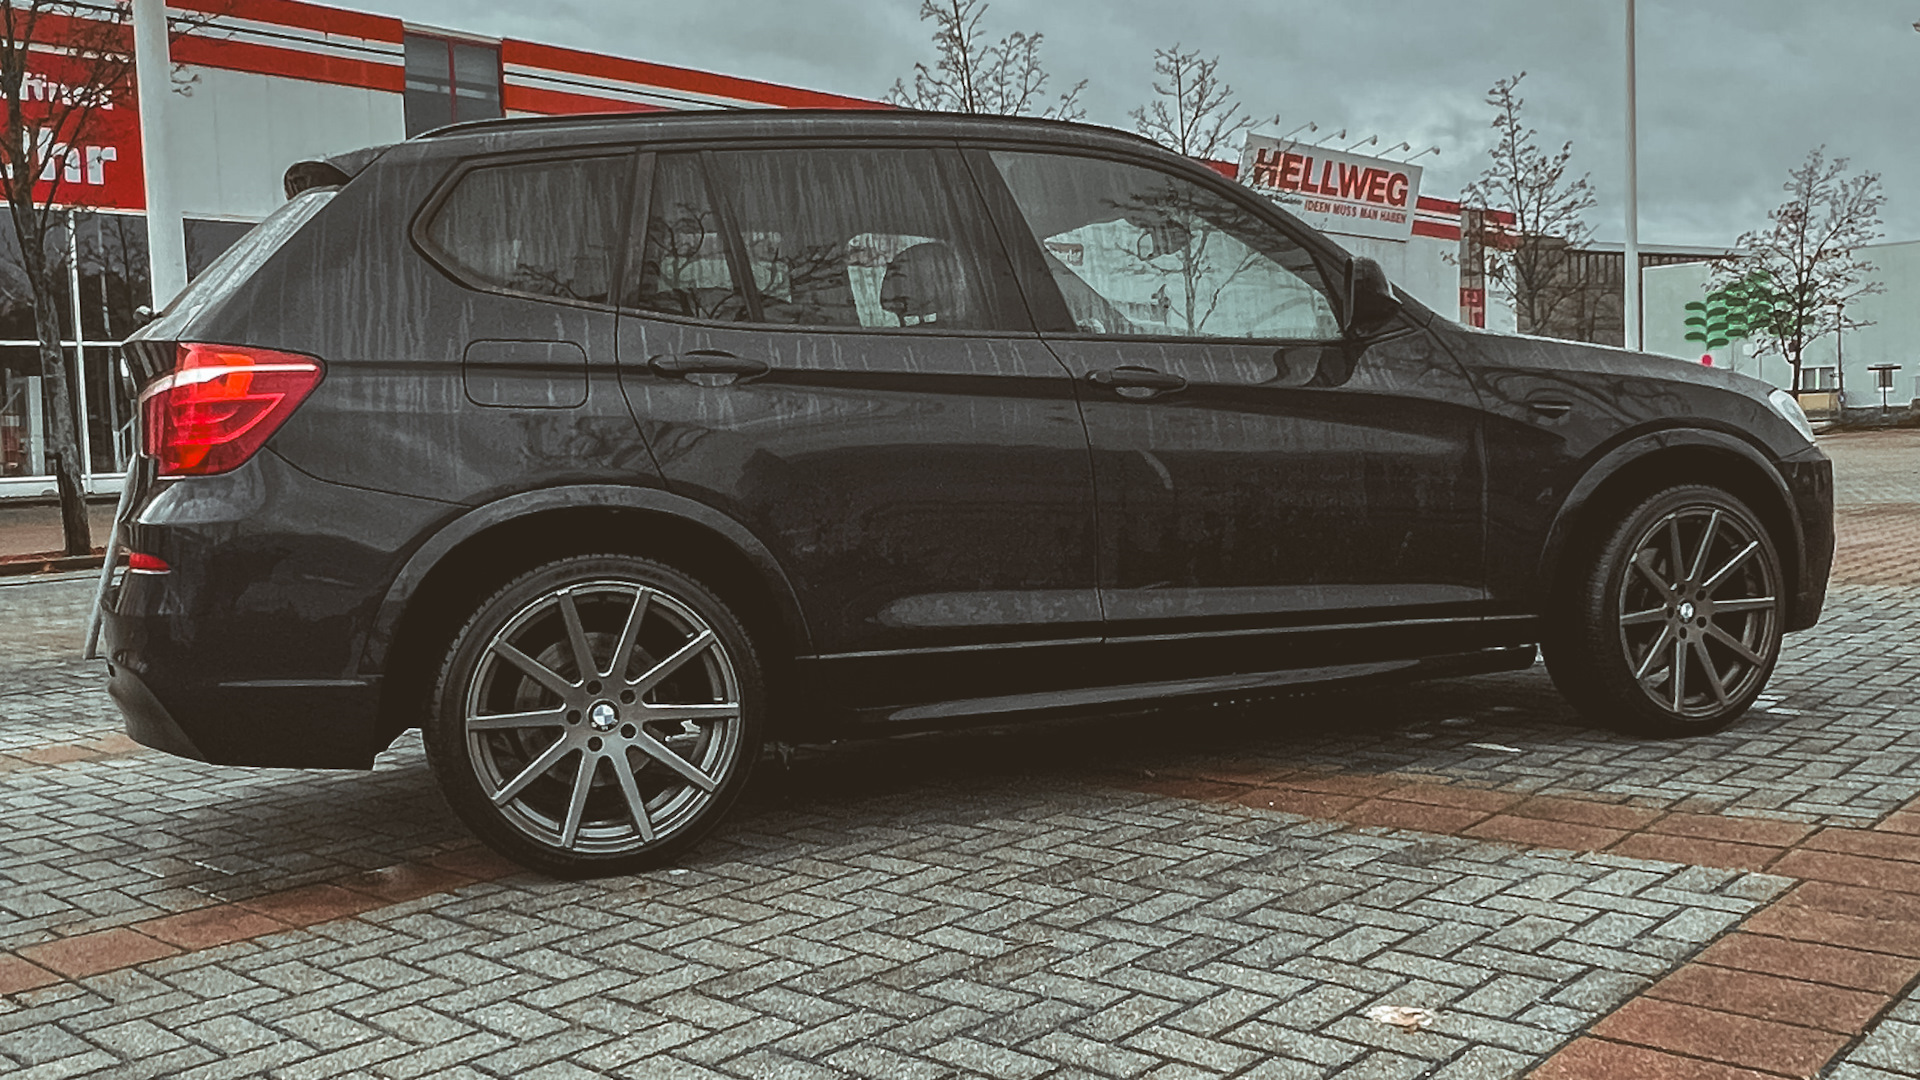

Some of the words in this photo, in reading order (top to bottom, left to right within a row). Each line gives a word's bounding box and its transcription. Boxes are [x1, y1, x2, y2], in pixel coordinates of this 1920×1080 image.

[1252, 148, 1409, 207] HELLWEG
[1304, 200, 1331, 213] IDEEN
[1332, 203, 1357, 217] MUSS
[1360, 207, 1378, 220] MAN
[1380, 210, 1407, 224] HABEN
